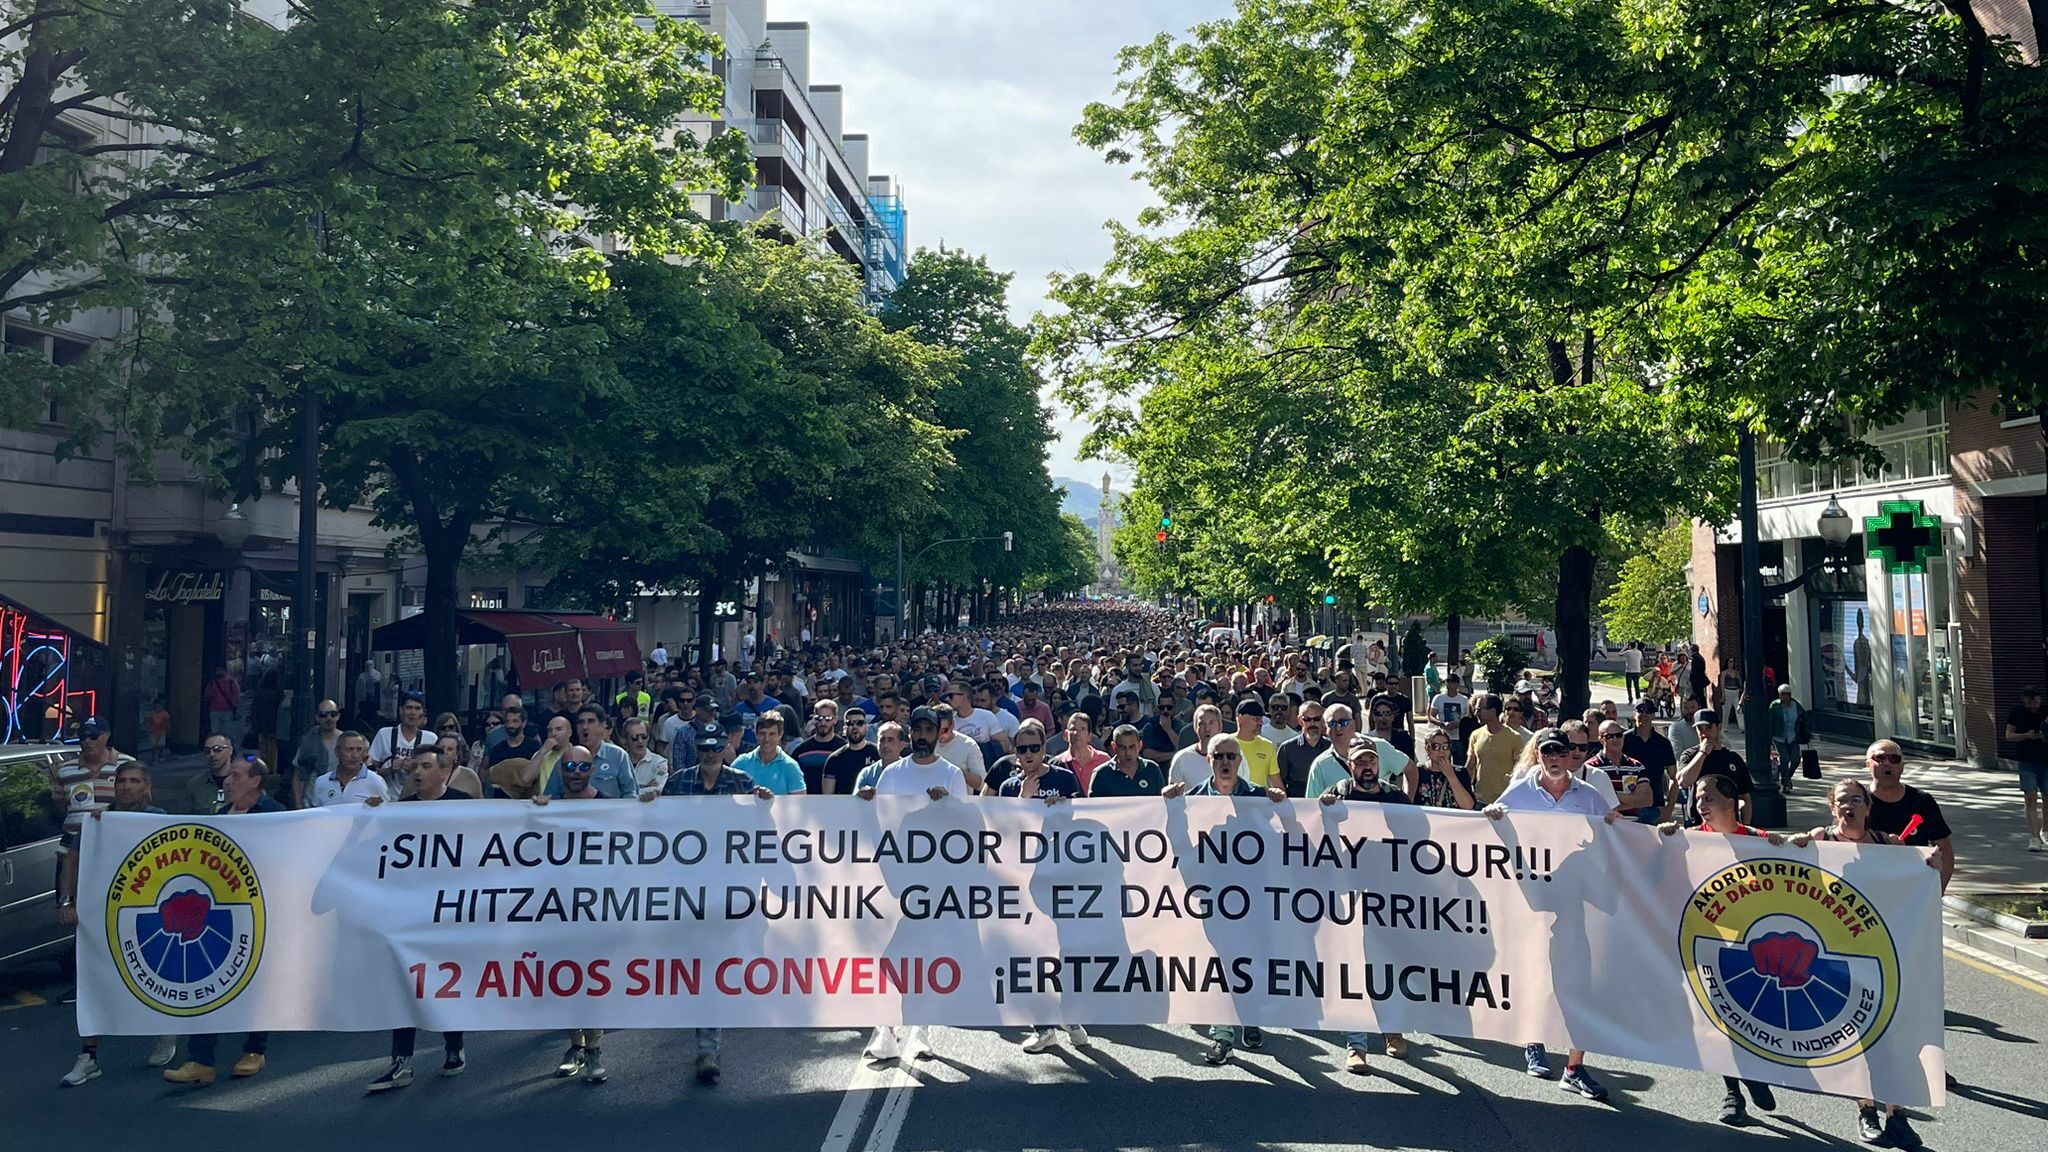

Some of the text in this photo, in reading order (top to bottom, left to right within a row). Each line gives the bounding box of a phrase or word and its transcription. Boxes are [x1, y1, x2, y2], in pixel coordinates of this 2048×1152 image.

[145, 570, 168, 600] La
[111, 828, 258, 902] SIN ACUERDO REGULADOR
[129, 847, 242, 895] NO HAY TOUR
[377, 829, 1552, 883] ¡SIN ACUERDO REGULADOR DIGNO, NO HAY TOUR!!!
[433, 885, 1488, 934] HITZARMEN DUINIK GABE, EZ DAGO TOURRIK!!
[1693, 863, 1879, 930] AKORDIORIK GABE
[1704, 878, 1866, 938] EZ DAGO TOURRIK
[124, 934, 249, 1000] ERTZAINAS EN LUCHA
[409, 952, 1511, 1011] 12 AÑOS SIN CONVENIO ¡ERTZAINAS EN LUCHA!
[1702, 964, 1875, 1052] ERTZAINAK INDARBIDEZ
